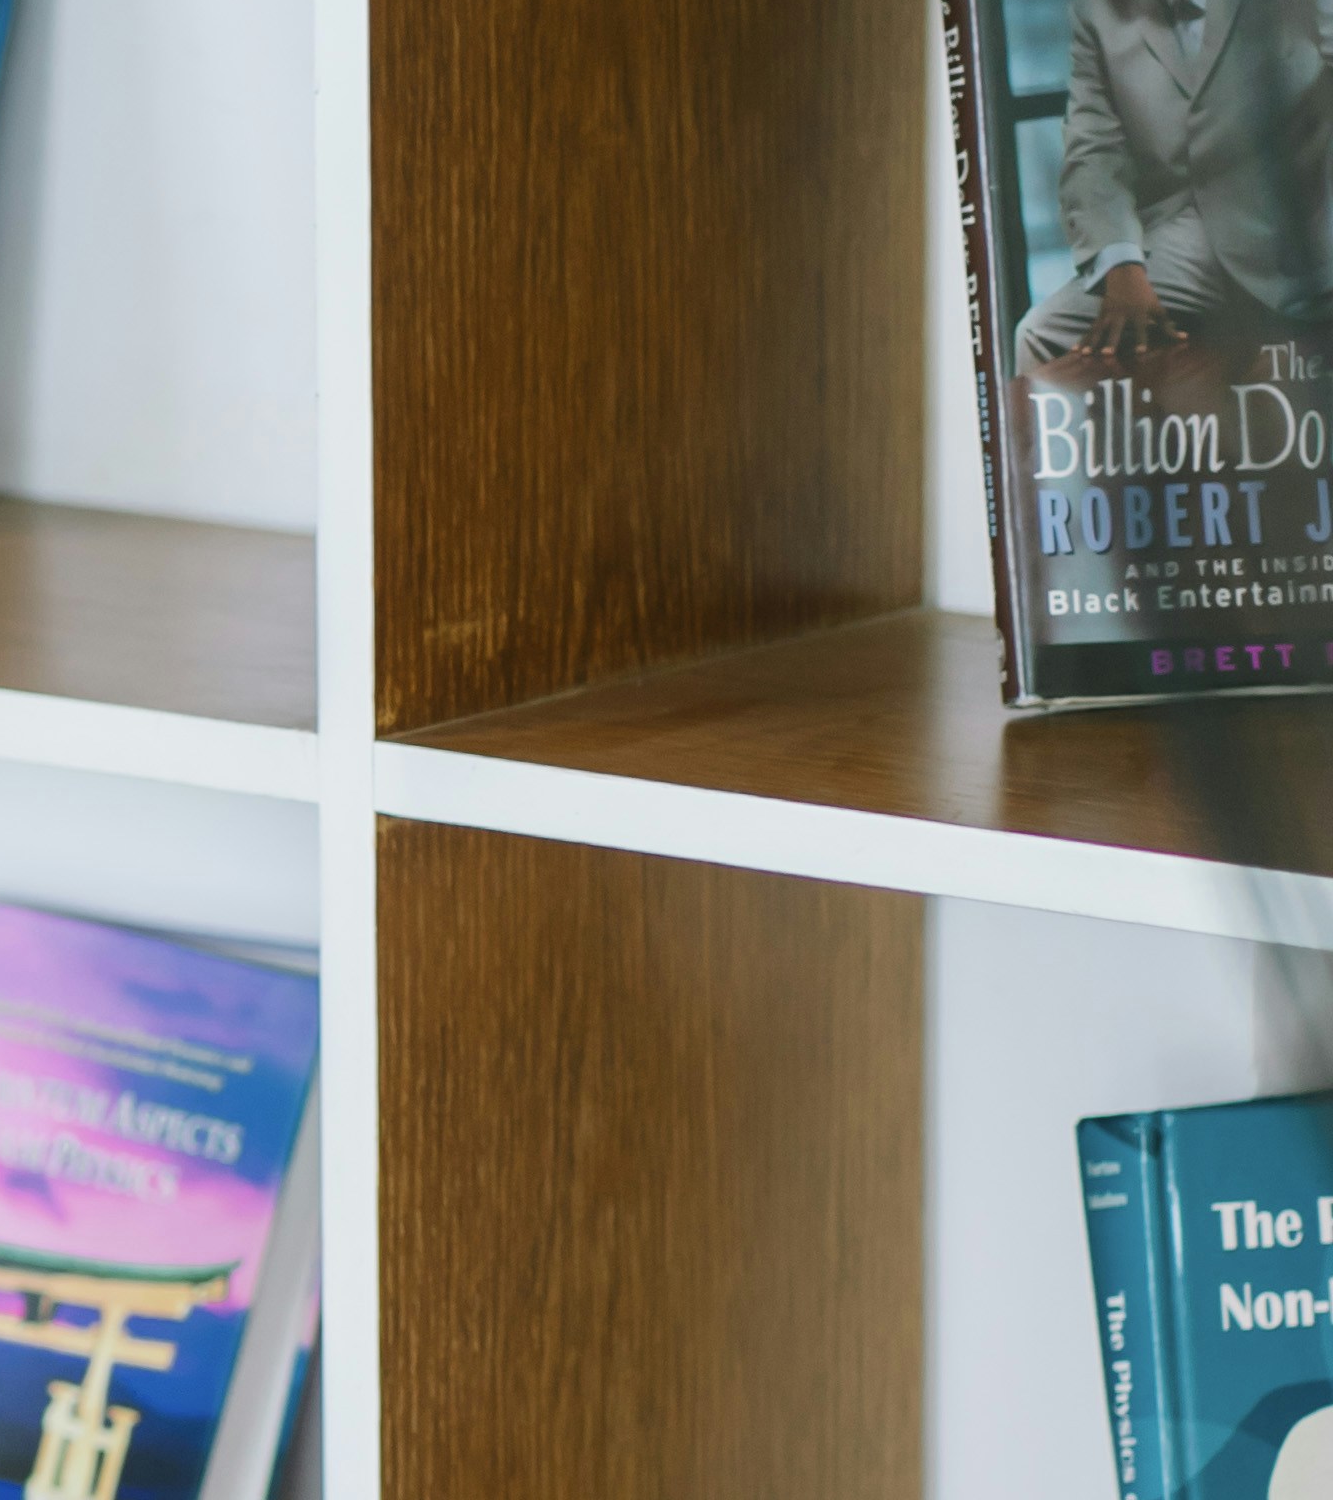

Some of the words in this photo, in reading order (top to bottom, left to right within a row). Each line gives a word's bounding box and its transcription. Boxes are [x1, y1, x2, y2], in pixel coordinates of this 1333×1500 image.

[1261, 341, 1323, 382] The
[1028, 378, 1225, 479] Billion
[1038, 481, 1266, 557] ROBERT
[1125, 562, 1179, 580] AND
[1196, 558, 1244, 577] THE
[1048, 588, 1139, 616] Black
[1151, 644, 1294, 677] BRETT
[1211, 1200, 1303, 1250] The
[1107, 1291, 1126, 1352] The
[1112, 1361, 1137, 1484] Physics
